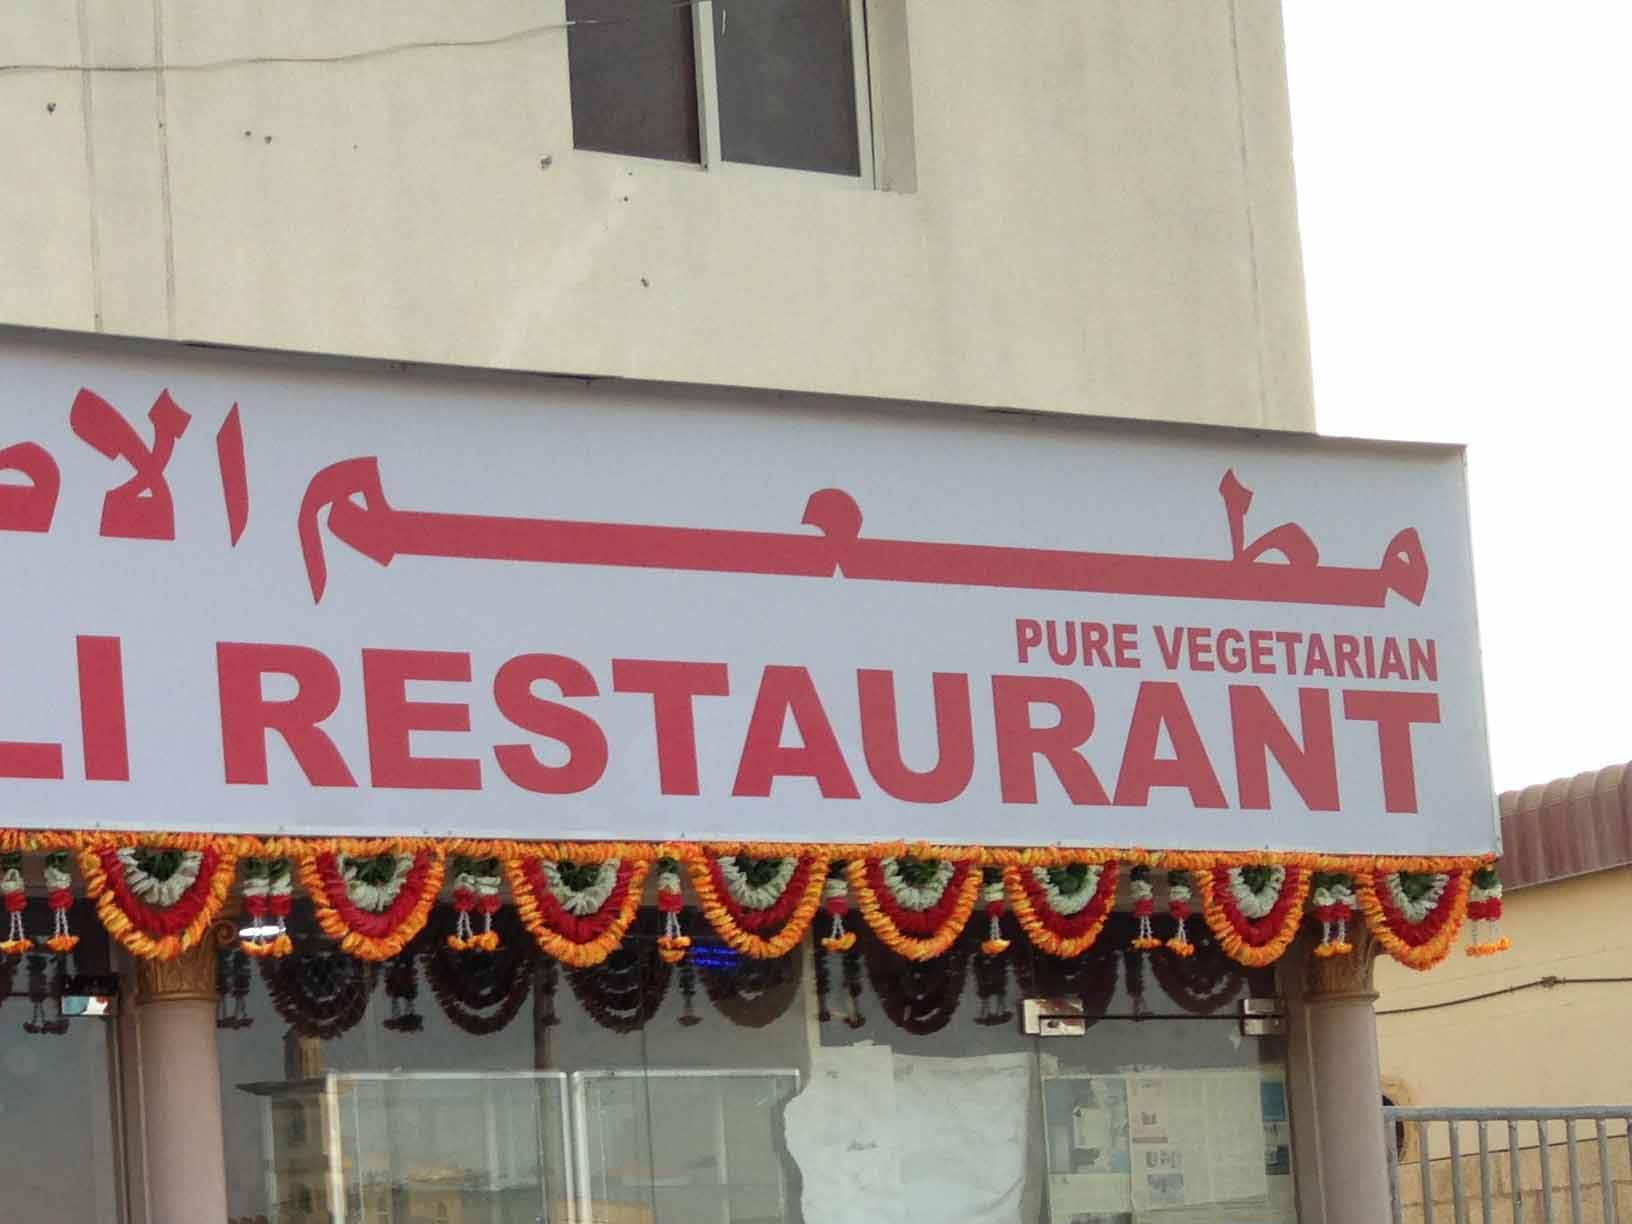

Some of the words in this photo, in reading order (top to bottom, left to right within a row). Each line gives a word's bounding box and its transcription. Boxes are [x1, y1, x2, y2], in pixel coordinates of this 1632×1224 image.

[298, 457, 1429, 609] مطعم
[1016, 618, 1142, 669] PURE
[1153, 625, 1439, 682] VEGETARIAN
[216, 641, 1442, 814] RESTAURANT
